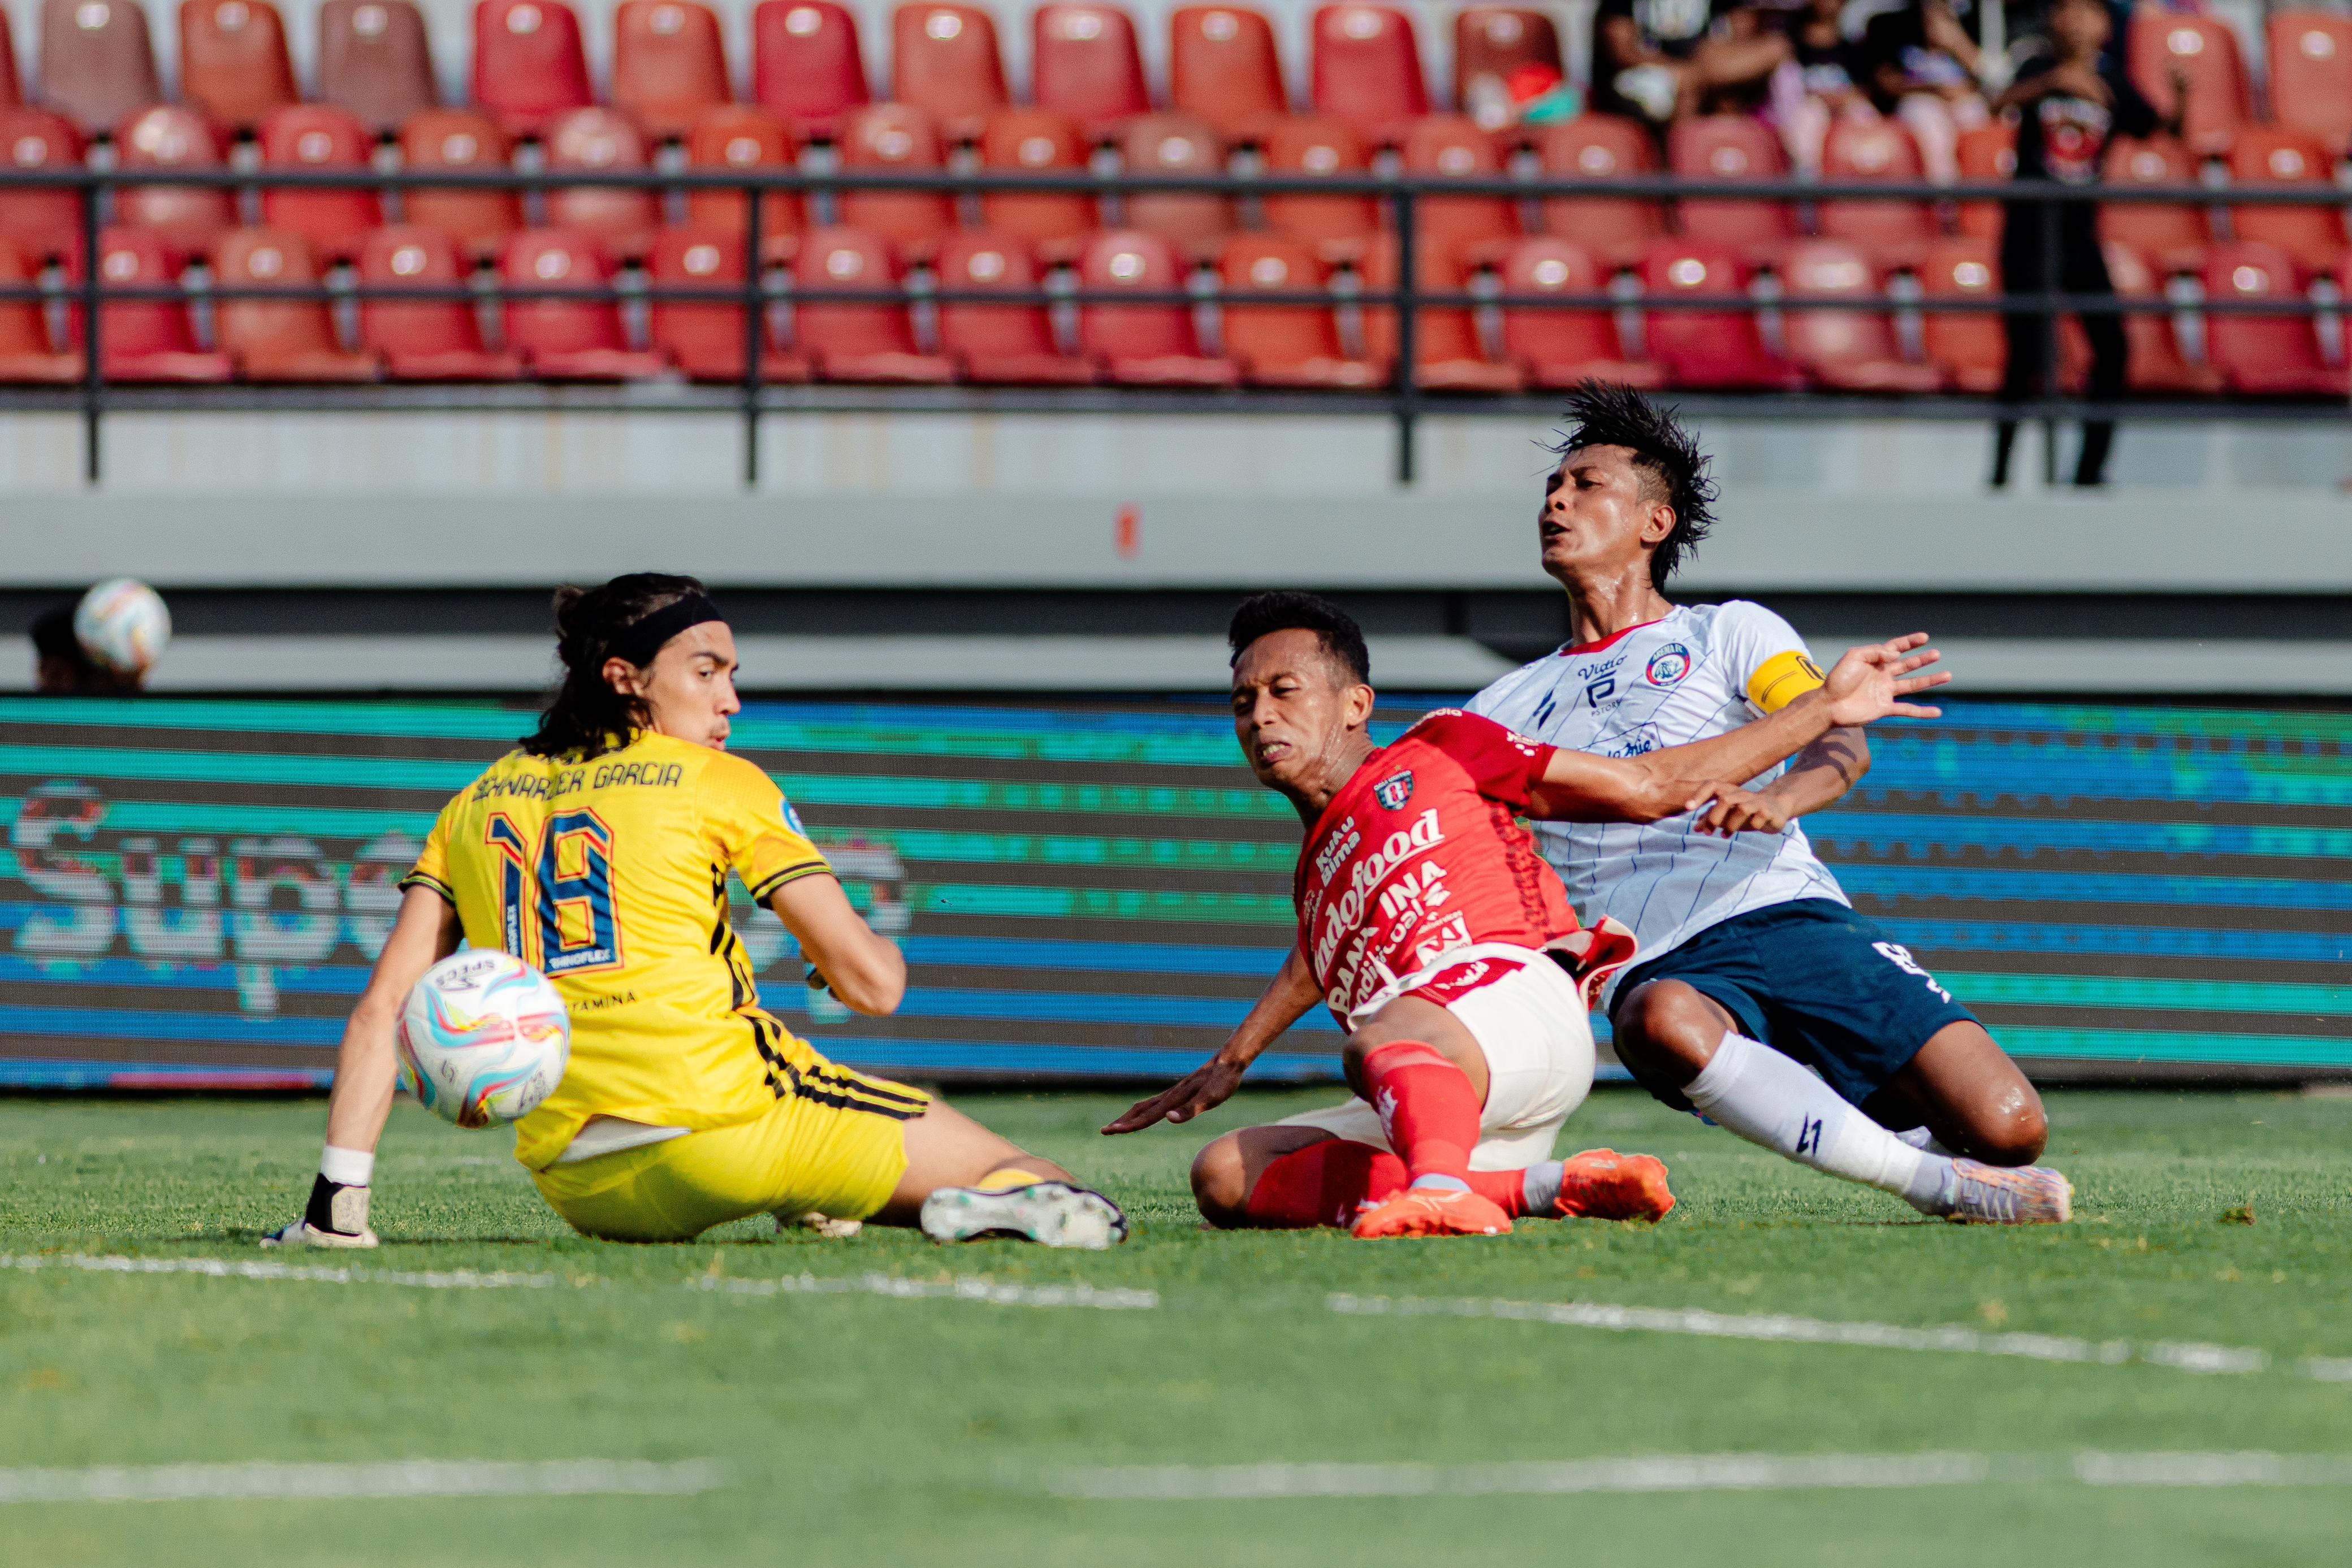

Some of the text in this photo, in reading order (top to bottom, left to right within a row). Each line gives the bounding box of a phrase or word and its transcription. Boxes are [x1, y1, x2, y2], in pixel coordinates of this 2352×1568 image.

[1577, 655, 1628, 680] Vidio
[1591, 699, 1623, 717] PSTORE
[593, 761, 683, 790] GARCIA
[485, 806, 625, 980] 18
[1378, 860, 1447, 919] INA
[571, 990, 636, 1012] TAMINA
